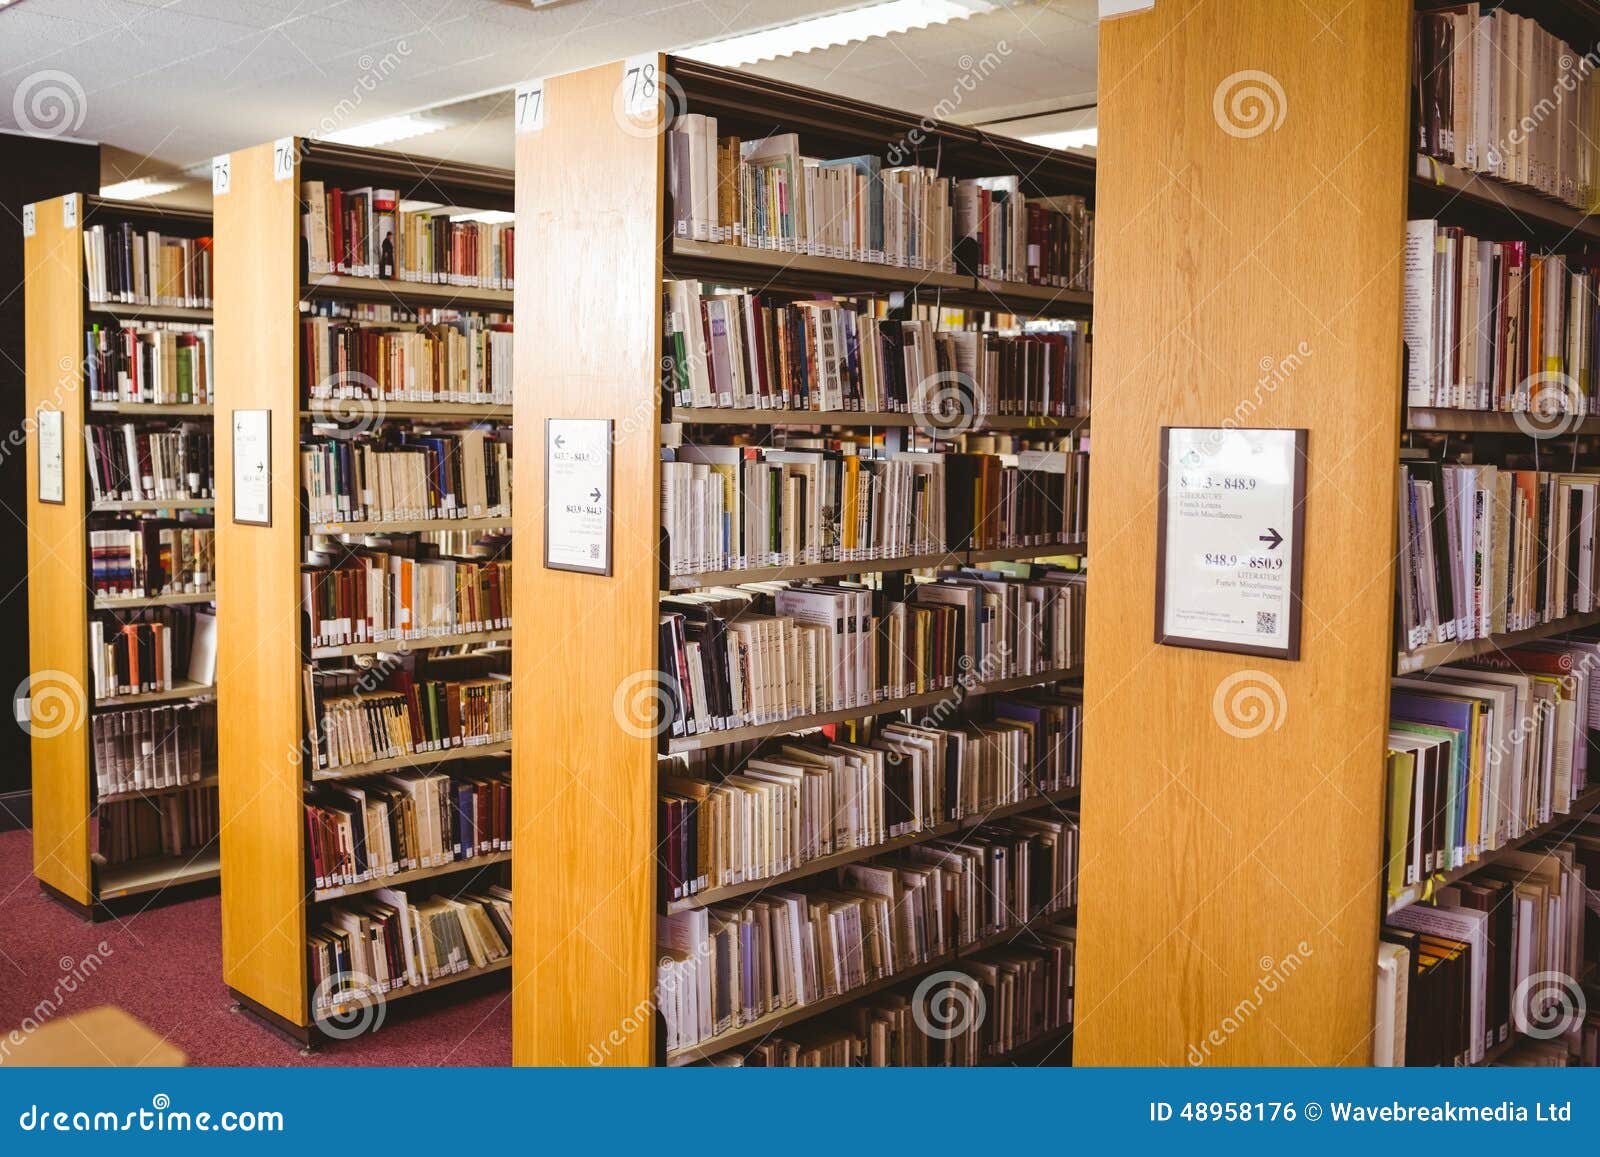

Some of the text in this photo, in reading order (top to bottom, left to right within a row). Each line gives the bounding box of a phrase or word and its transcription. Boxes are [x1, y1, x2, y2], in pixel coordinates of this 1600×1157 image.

[626, 63, 655, 103] 78
[518, 89, 542, 125] 77
[276, 145, 292, 173] 76
[214, 163, 228, 190] 75
[1180, 475, 1212, 489] 8.3
[1224, 478, 1257, 490] 848.9
[1205, 553, 1238, 567] 848.9
[1249, 556, 1283, 570] 850.9
